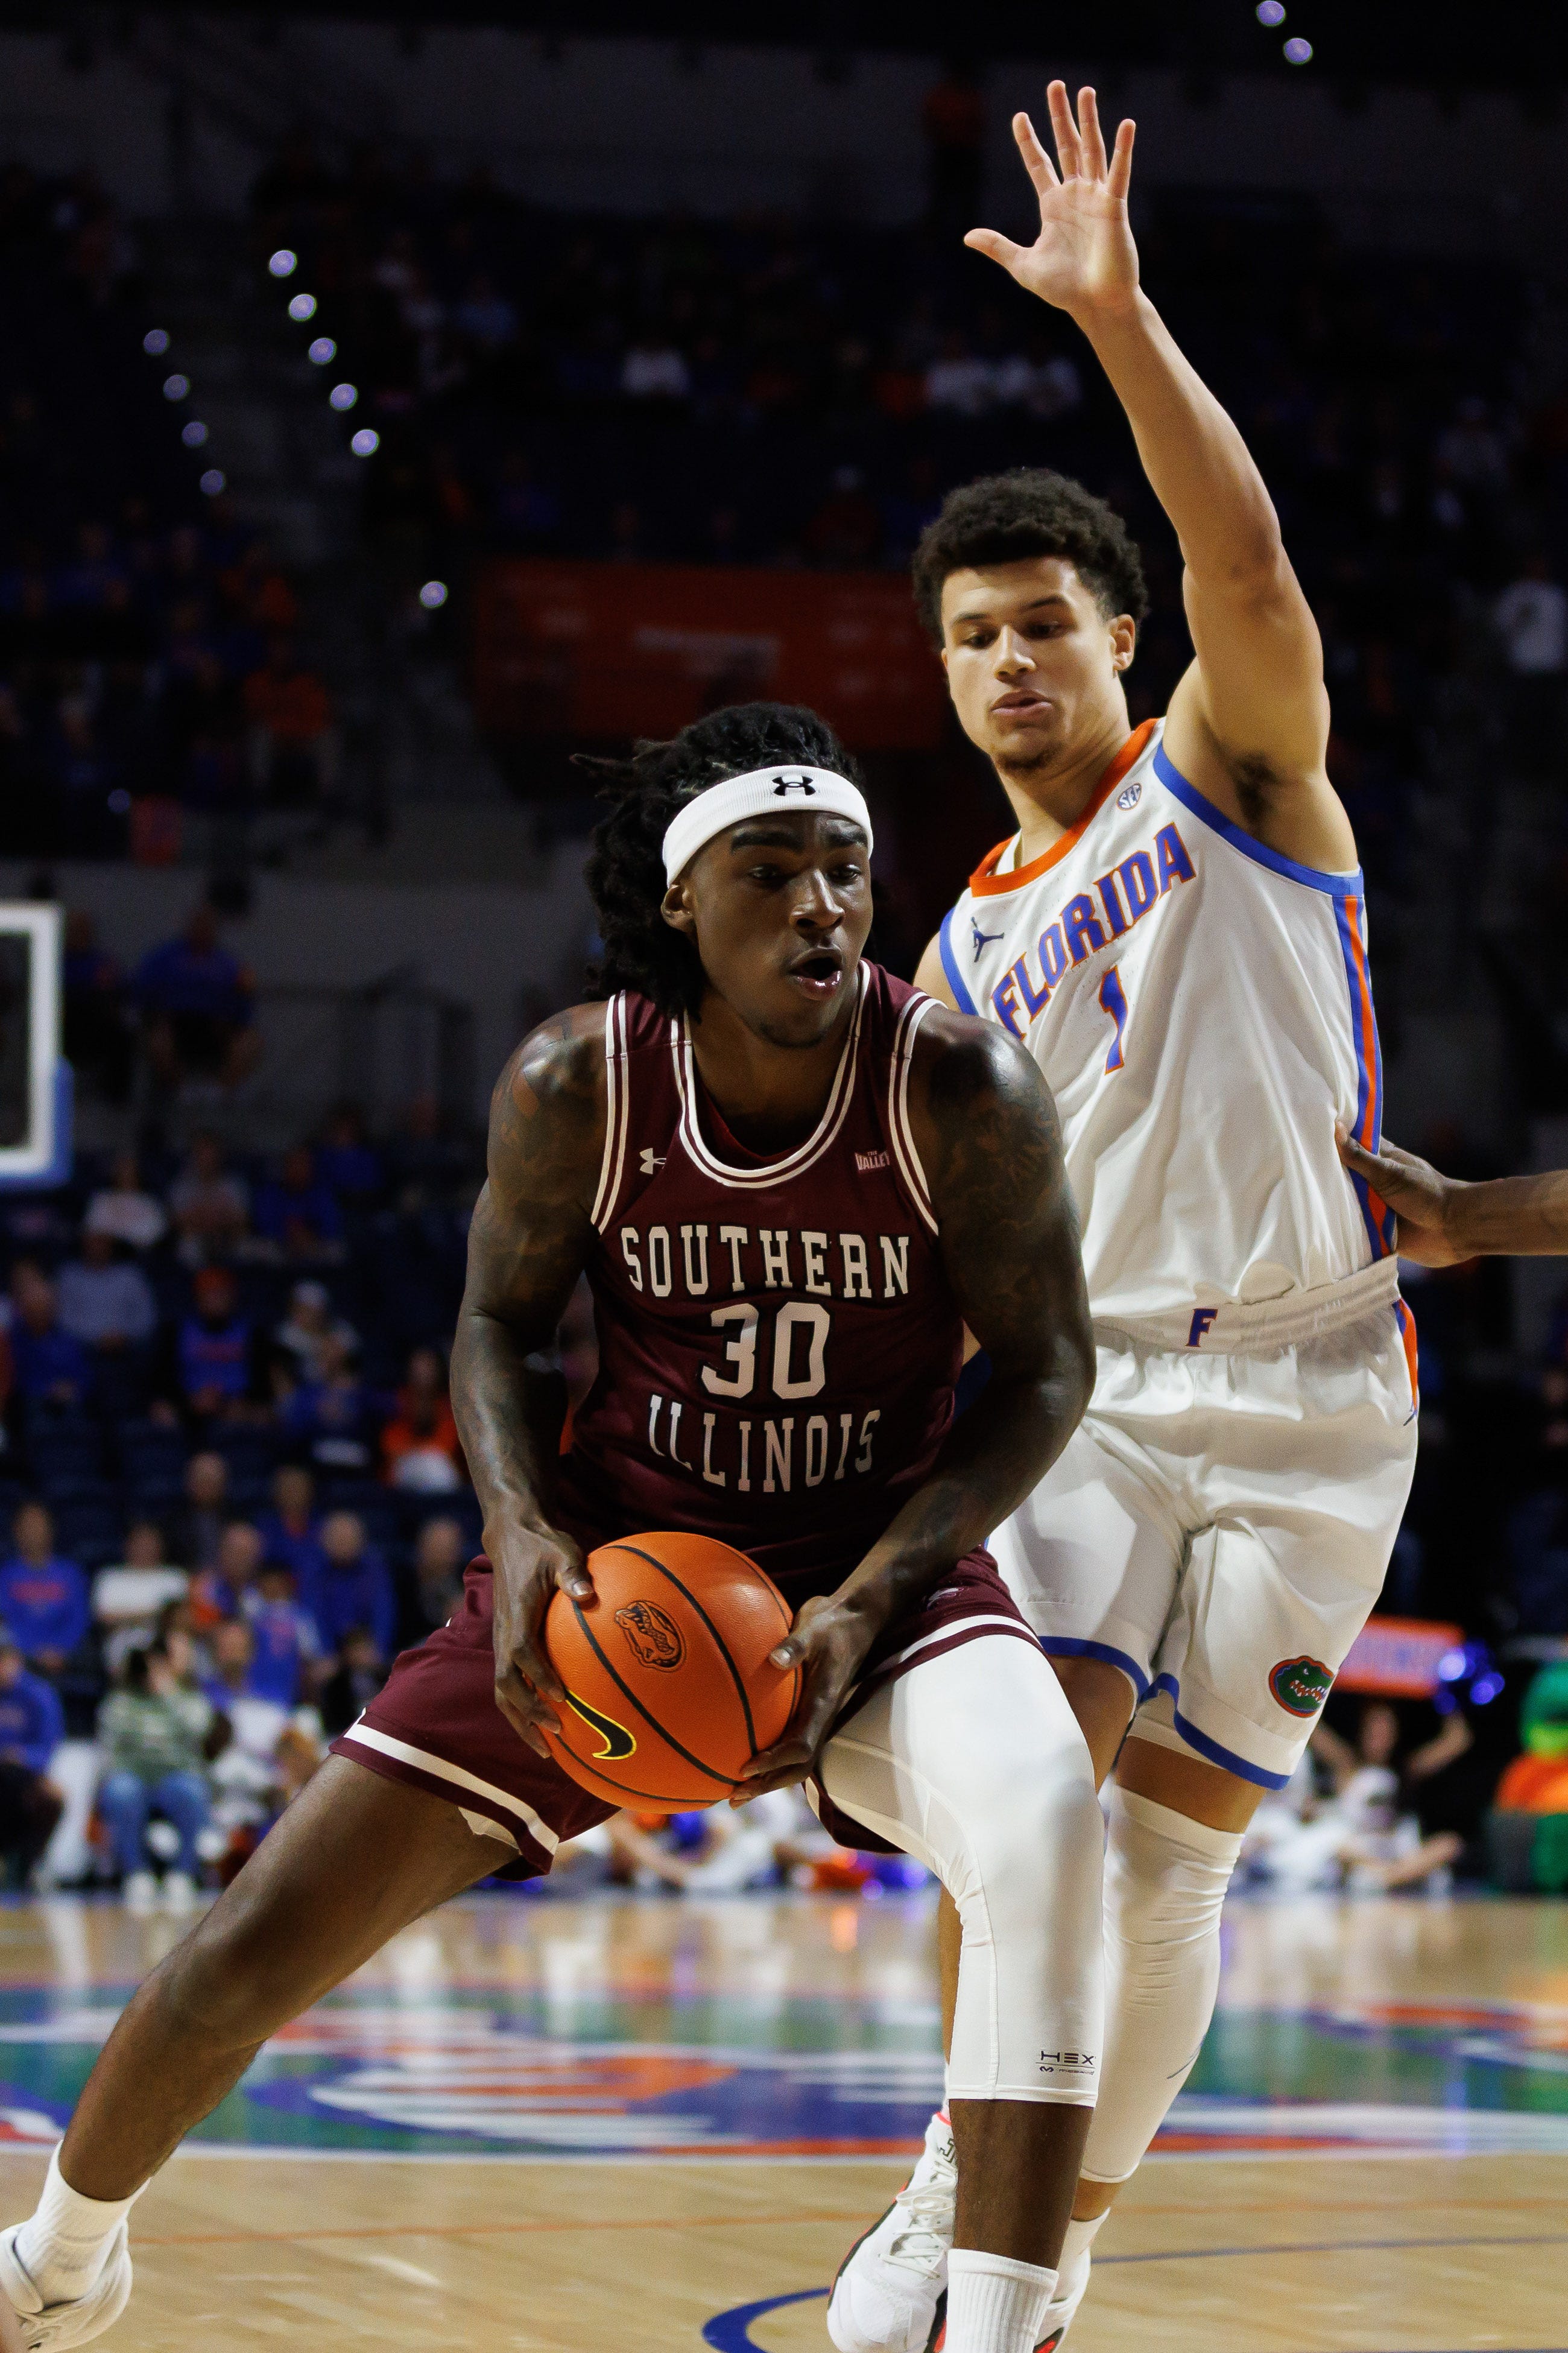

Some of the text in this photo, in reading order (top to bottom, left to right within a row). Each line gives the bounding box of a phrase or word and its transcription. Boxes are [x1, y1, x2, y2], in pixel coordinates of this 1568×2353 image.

[991, 822, 1196, 1041] FLORIDA
[1099, 965, 1129, 1075] 1
[855, 1150, 891, 1171] VALLEY
[620, 1224, 909, 1299] SOUTHERN
[701, 1300, 831, 1399] 30
[1184, 1308, 1219, 1348] F
[648, 1394, 881, 1493] ILLINOIS
[1040, 2050, 1095, 2066] HEX
